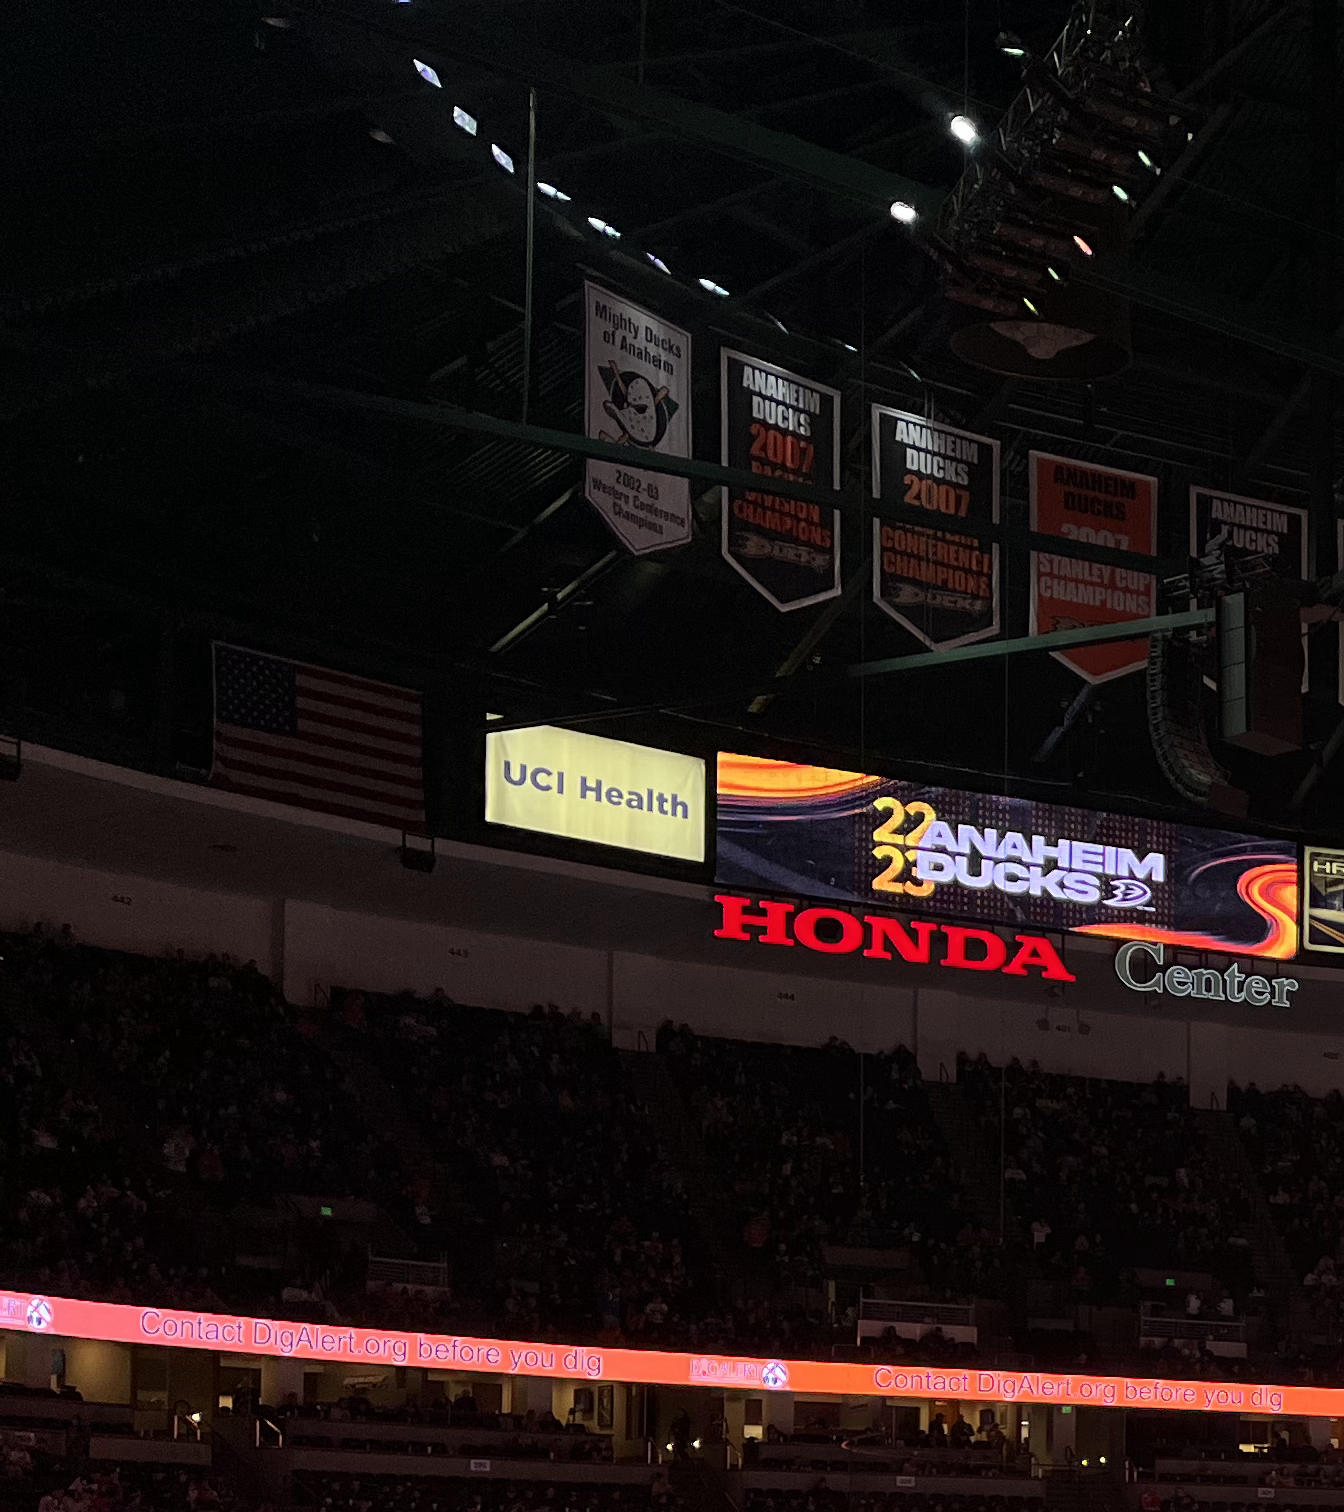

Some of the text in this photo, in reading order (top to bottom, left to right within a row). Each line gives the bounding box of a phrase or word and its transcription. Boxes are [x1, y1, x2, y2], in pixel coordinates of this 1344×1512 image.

[594, 299, 682, 360] Mighty Ducks
[603, 328, 674, 377] of Anaheim
[742, 365, 821, 415] ANAHEIM
[752, 395, 812, 437] DUCKS
[750, 423, 816, 475] 2007
[895, 420, 979, 465] ANAHEIM
[906, 447, 969, 486] DUCKS
[904, 473, 971, 518] 2007
[1053, 464, 1137, 500] ANAHEIM
[1063, 489, 1126, 521] DUCKS
[1211, 498, 1288, 535] ANAHEIM
[1039, 552, 1150, 592] STANLEY CUP
[1039, 576, 1149, 615] CHAMPIONS
[504, 760, 689, 820] UCI Health
[872, 797, 936, 847] 22
[872, 845, 936, 897] 23
[917, 821, 1165, 882] ANAHEIM
[917, 849, 1101, 907] DUCKS
[714, 895, 1299, 1007] HONDA Center
[140, 1310, 602, 1377] Contact DigAlert.org before you dig
